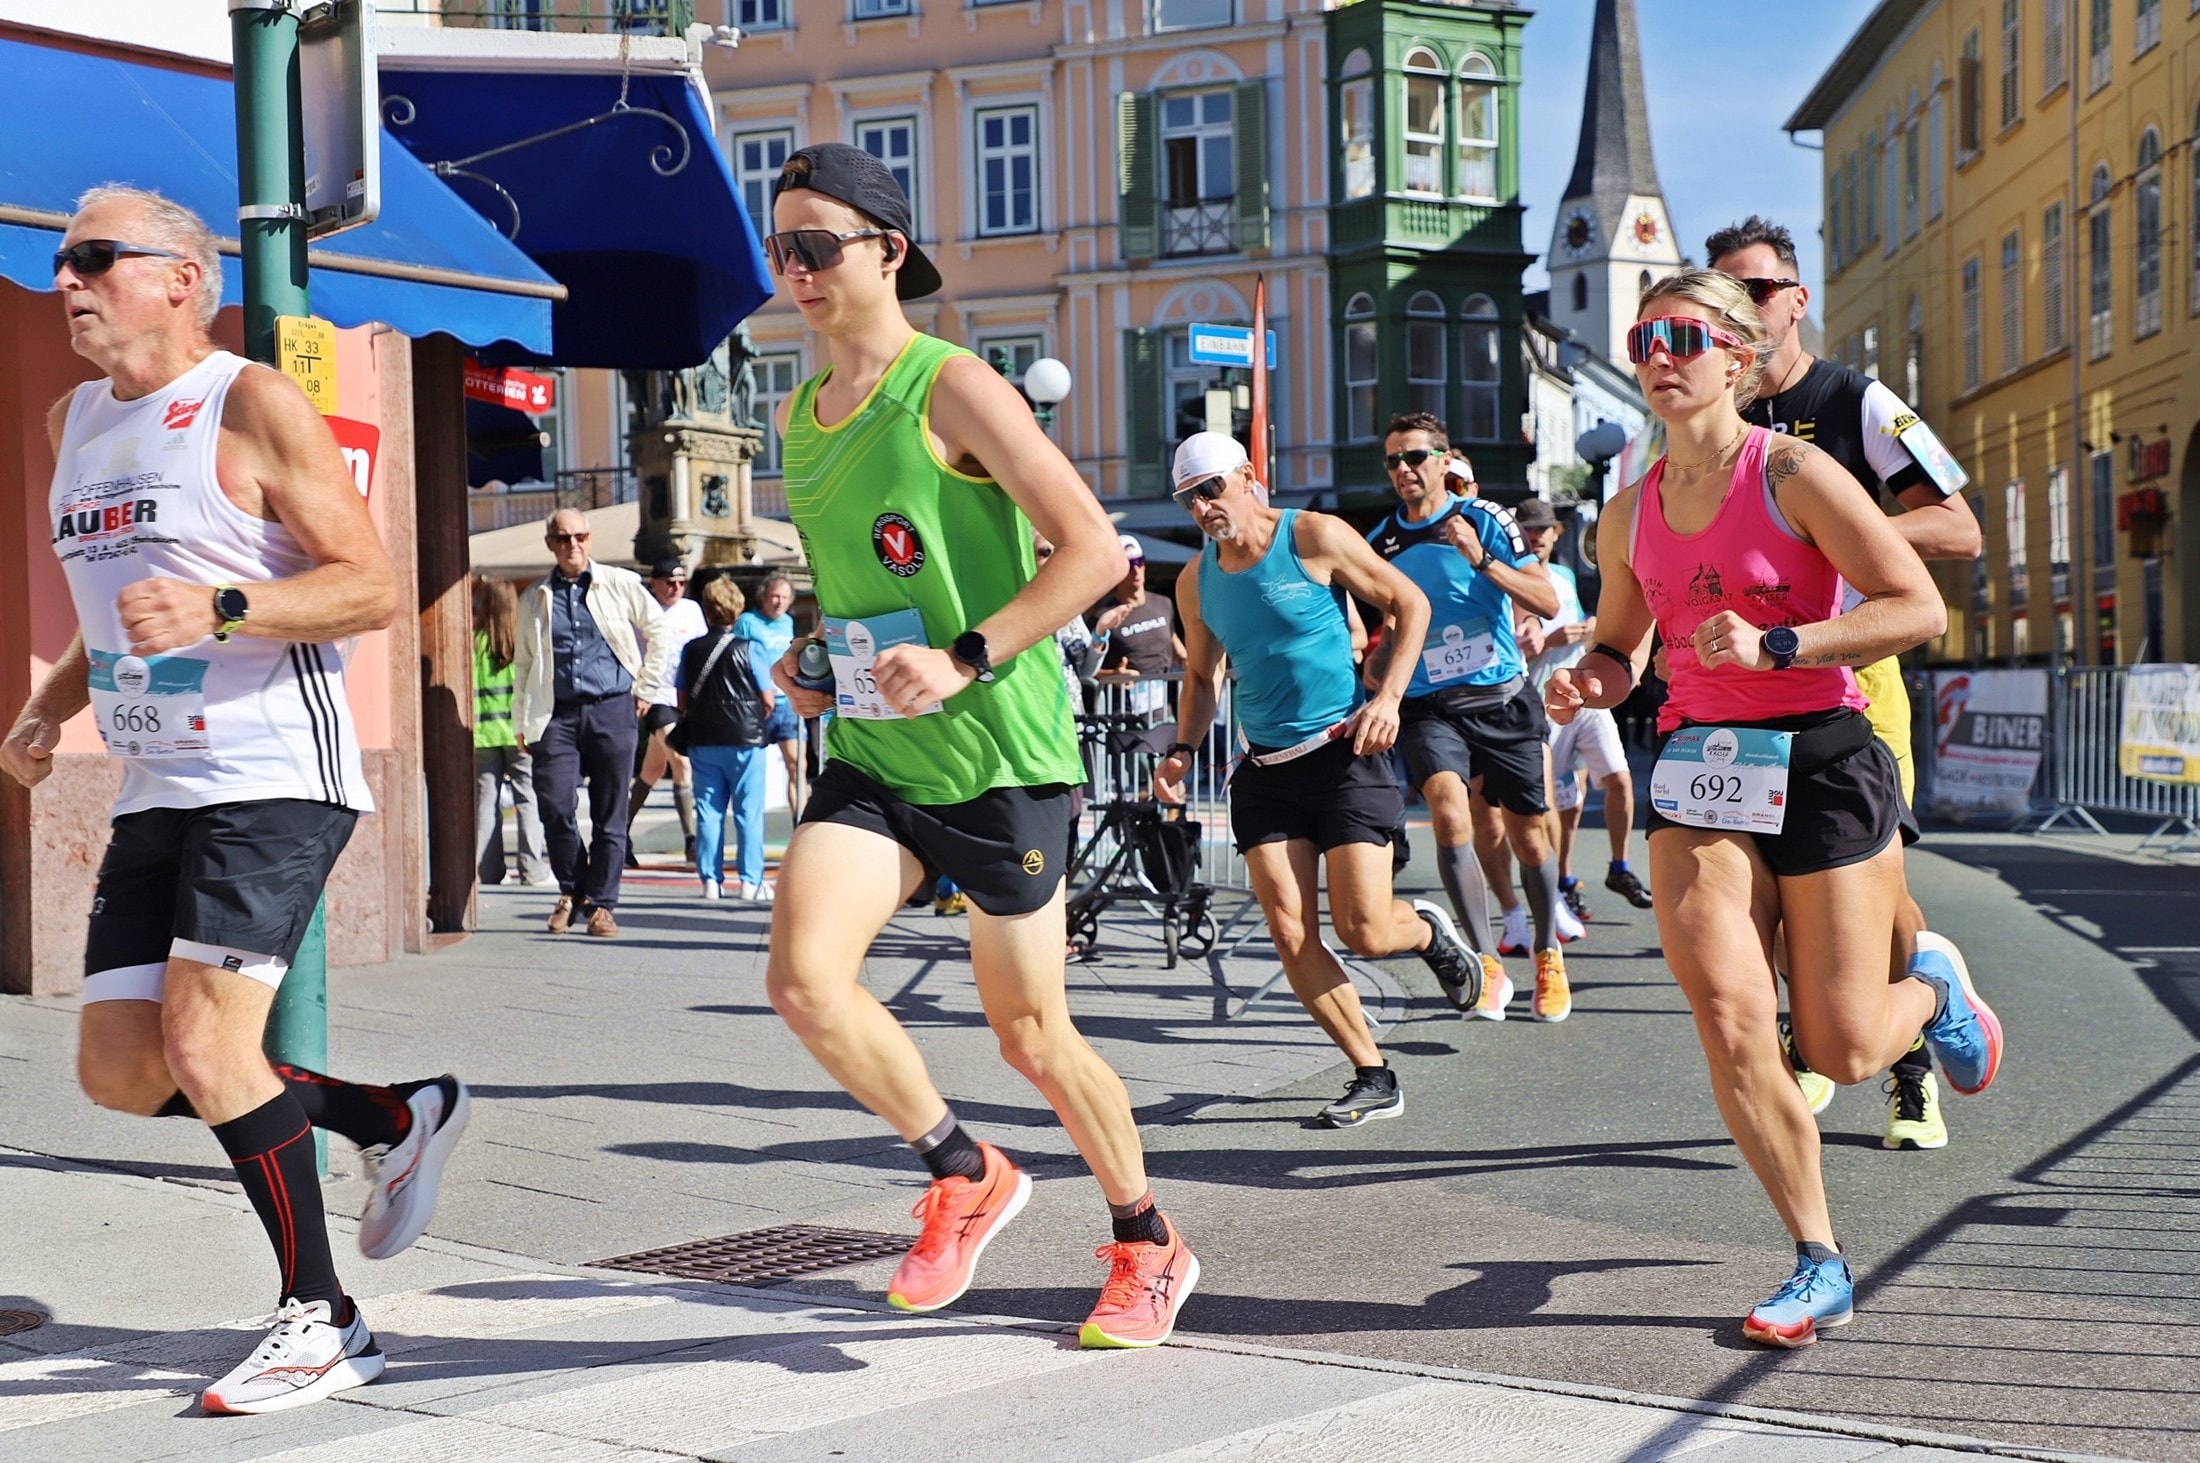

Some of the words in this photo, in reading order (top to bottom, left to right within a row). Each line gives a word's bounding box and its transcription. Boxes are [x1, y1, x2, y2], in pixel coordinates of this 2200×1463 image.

[284, 338, 298, 352] HK
[305, 340, 319, 354] 33
[1200, 337, 1248, 354] EINBAHN
[306, 379, 320, 393] 08
[465, 376, 527, 401] OTTERIEN
[53, 499, 157, 543] AUBER
[874, 514, 915, 540] BERGSPORT
[883, 552, 924, 576] VASOLD
[1444, 645, 1472, 665] 637
[854, 668, 878, 694] 65
[113, 704, 161, 733] 668
[1690, 774, 1744, 803] 692
